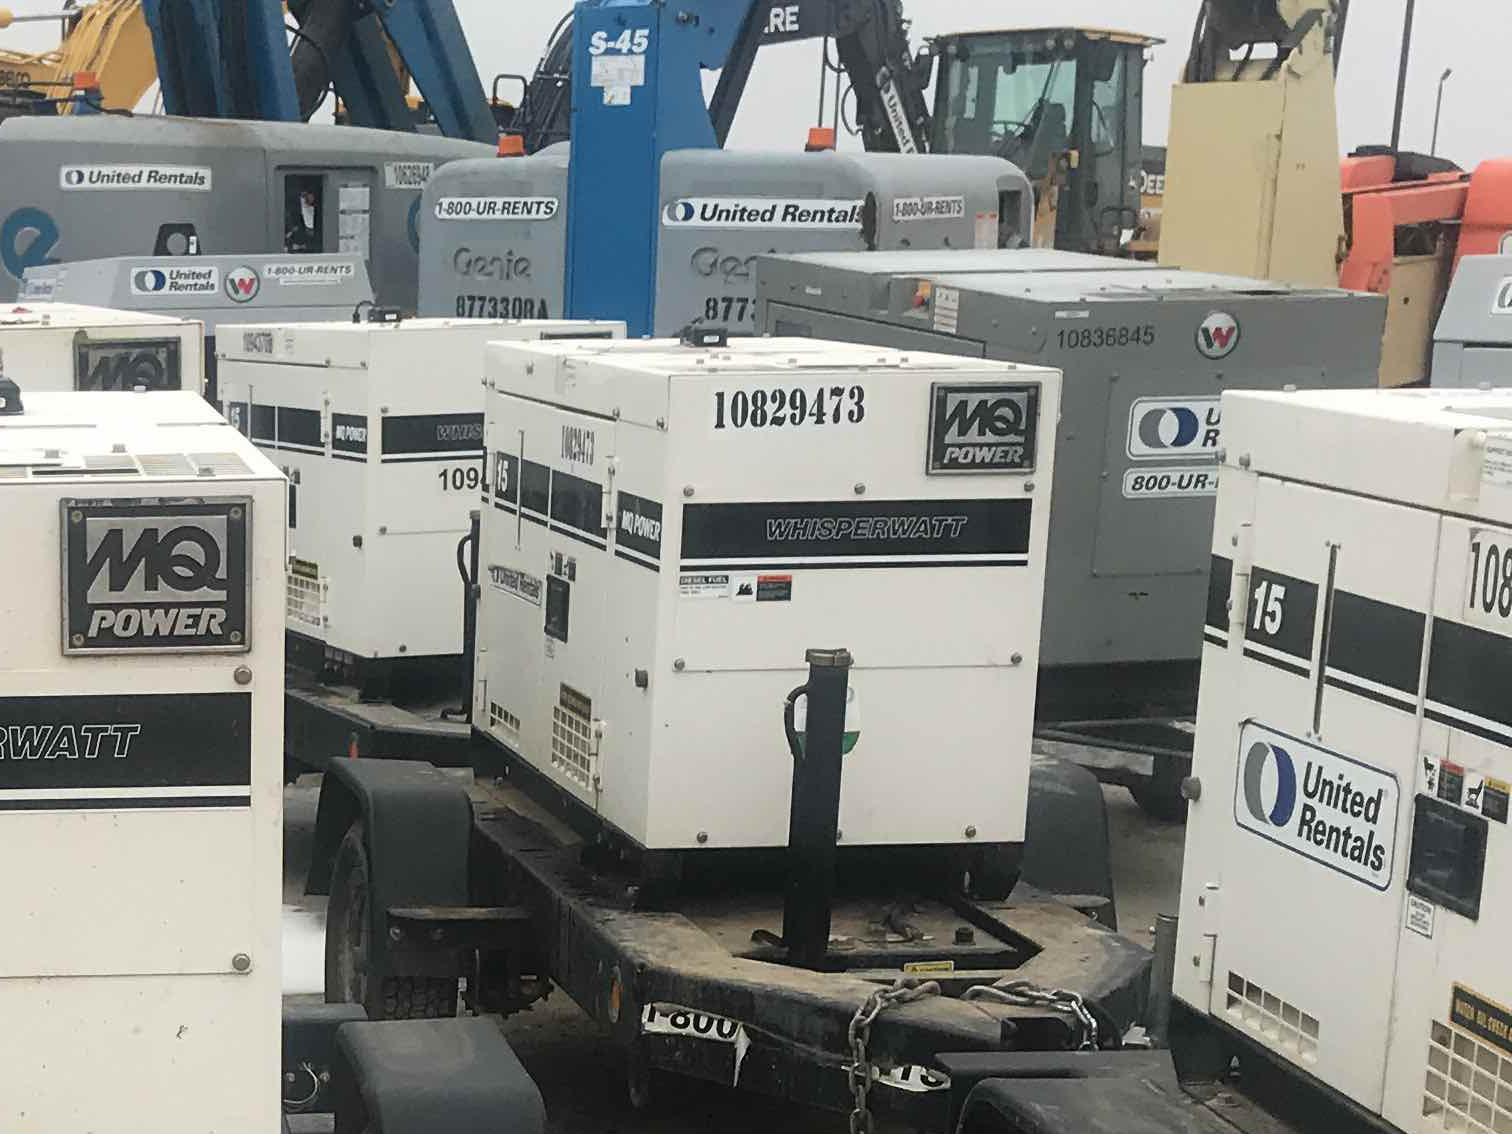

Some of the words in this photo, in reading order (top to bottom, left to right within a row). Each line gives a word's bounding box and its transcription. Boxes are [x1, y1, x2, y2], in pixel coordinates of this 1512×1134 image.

[763, 6, 799, 33] RE
[588, 29, 650, 55] S-45
[88, 170, 142, 185] United
[146, 170, 206, 186] Rentals
[437, 200, 555, 217] 1-800-UR-RENTS
[699, 203, 775, 223] United
[895, 196, 963, 217] 1-800-UR-RENTS
[168, 269, 212, 281] United
[168, 280, 216, 292] Rentals
[1056, 326, 1155, 350] 10836845
[713, 385, 866, 430] 10829473
[944, 399, 1026, 438] MQ
[942, 445, 1025, 465] POWER
[438, 466, 482, 491] 109
[1131, 473, 1220, 491] 800-UR-
[634, 514, 661, 542] POWER
[766, 515, 968, 542] WHISPERWATT
[87, 525, 228, 592] MQ
[1253, 580, 1286, 635] 15
[87, 607, 228, 639] POWER
[1302, 761, 1384, 826] United
[1297, 808, 1386, 873] Rentals
